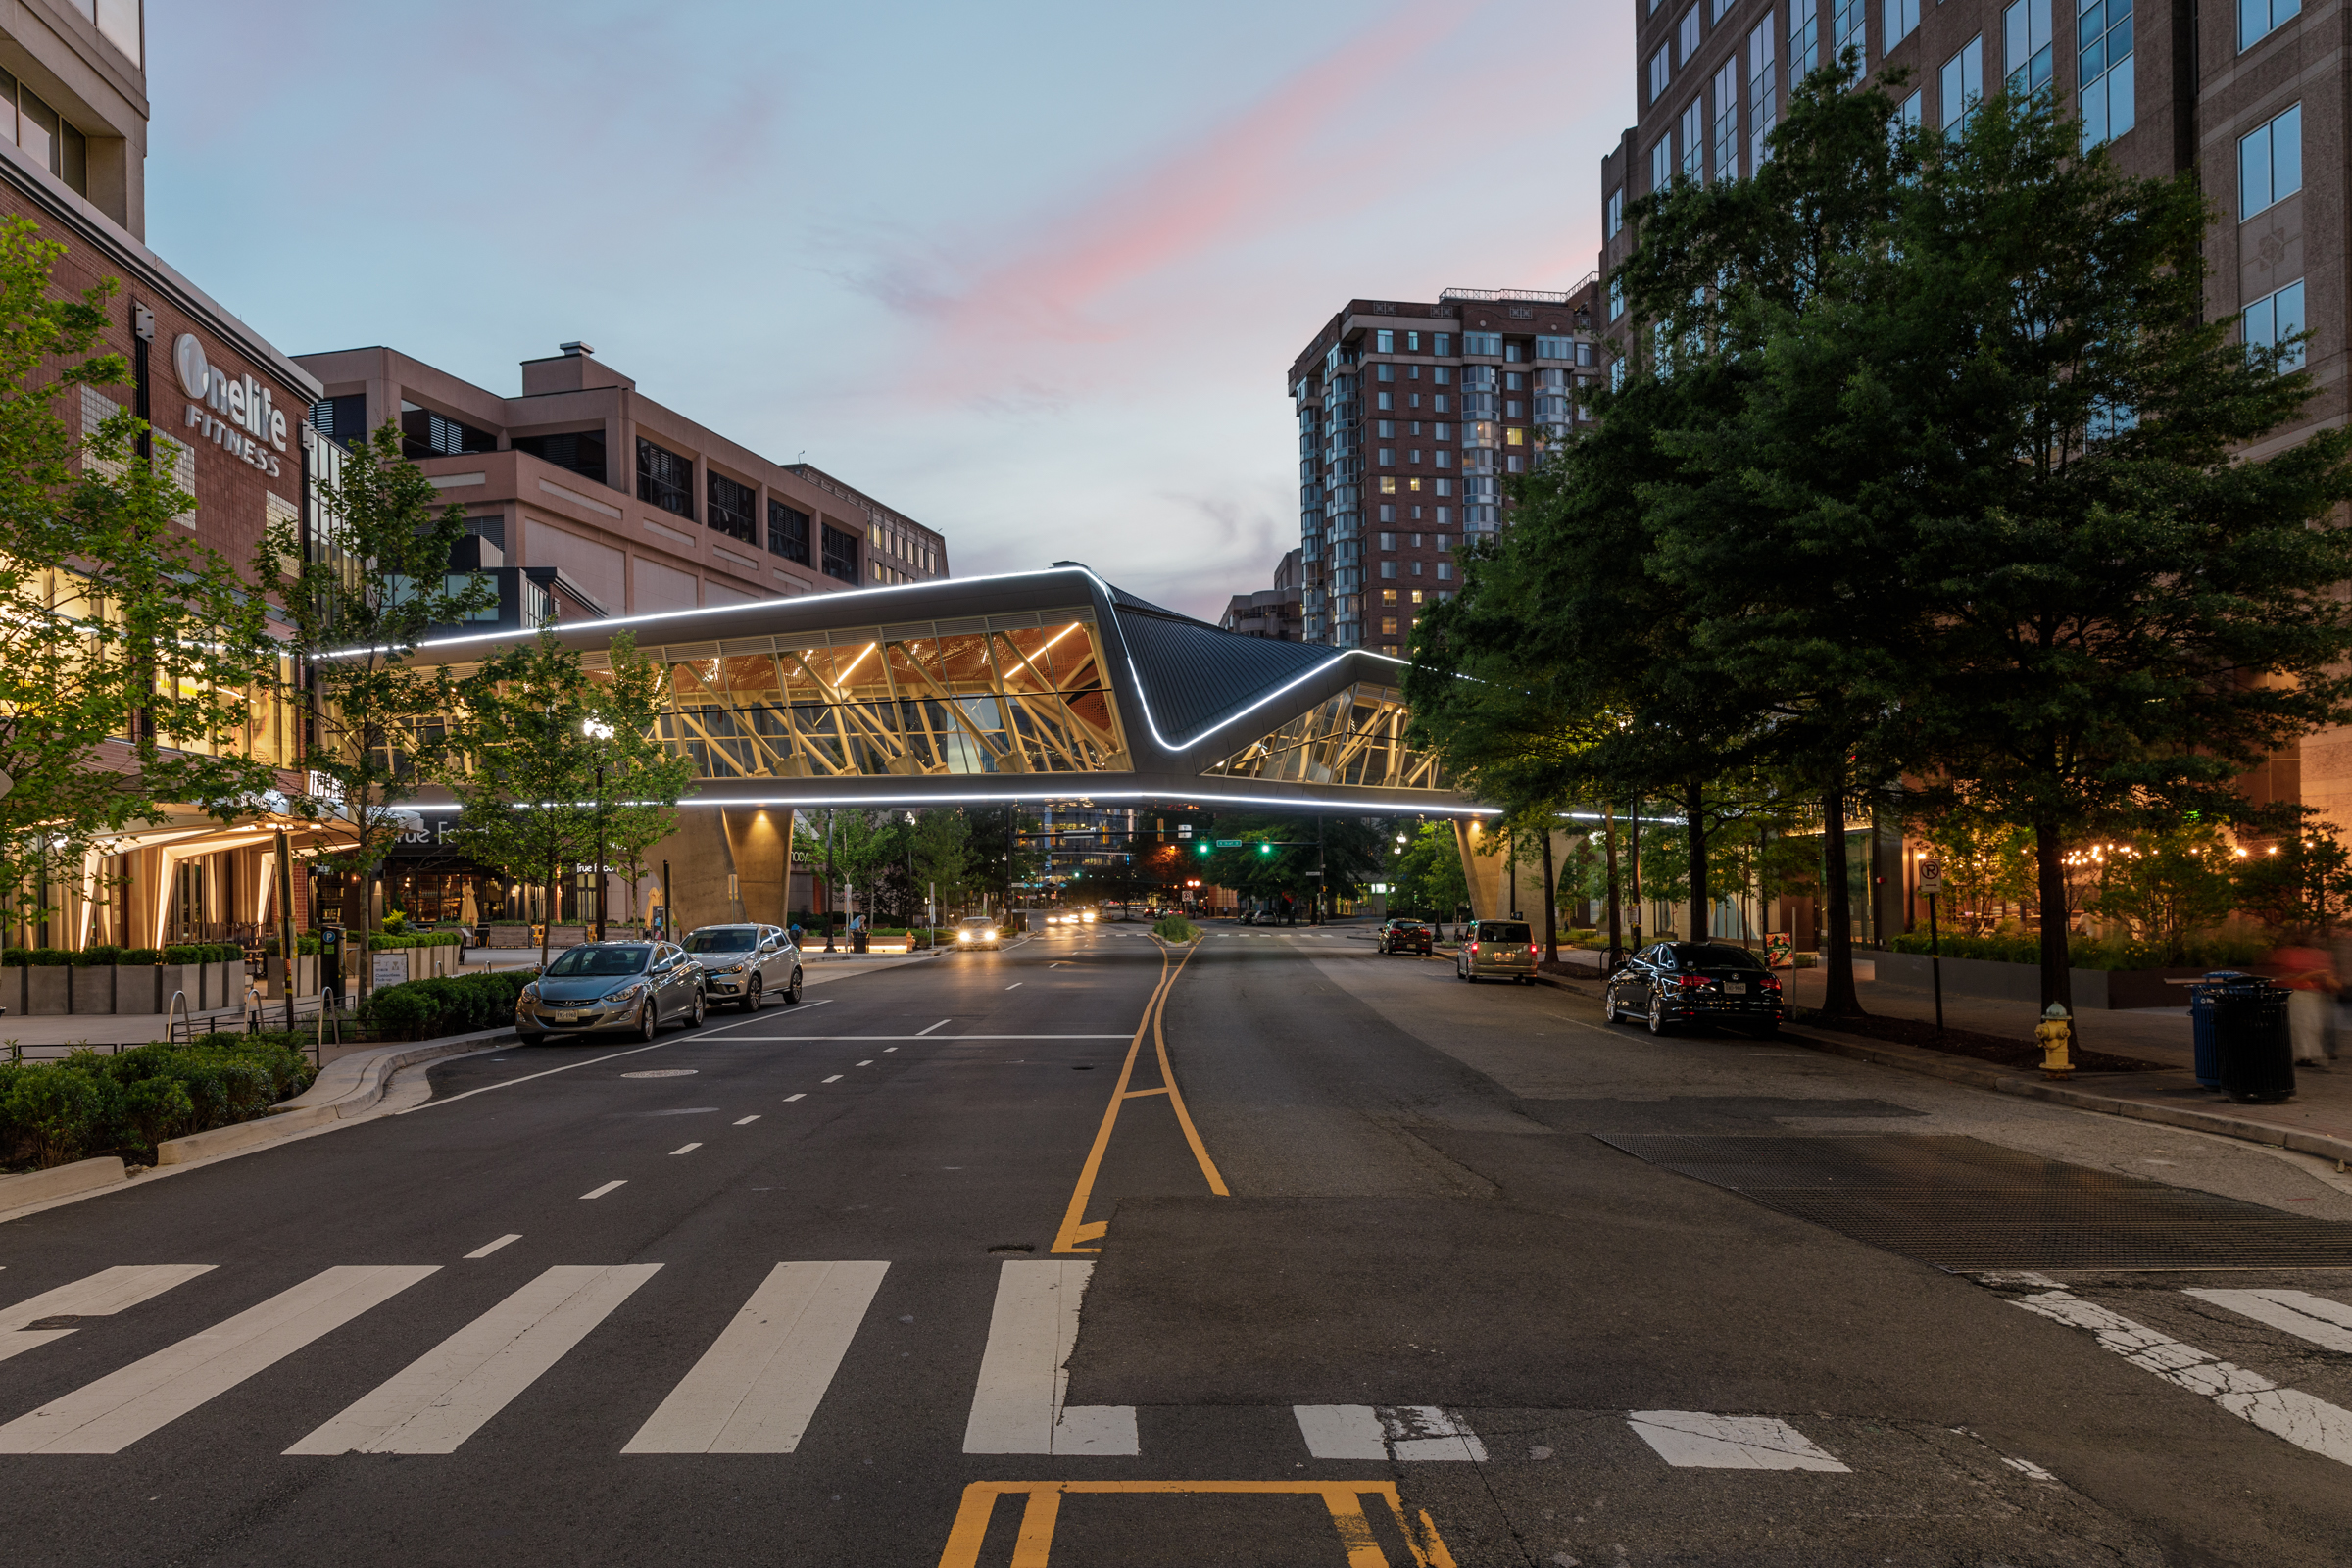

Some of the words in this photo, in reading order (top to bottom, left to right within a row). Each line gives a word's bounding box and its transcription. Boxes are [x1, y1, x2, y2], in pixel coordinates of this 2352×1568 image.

[173, 333, 287, 452] Onelife
[185, 404, 280, 477] FITNESS
[394, 827, 430, 844] rue
